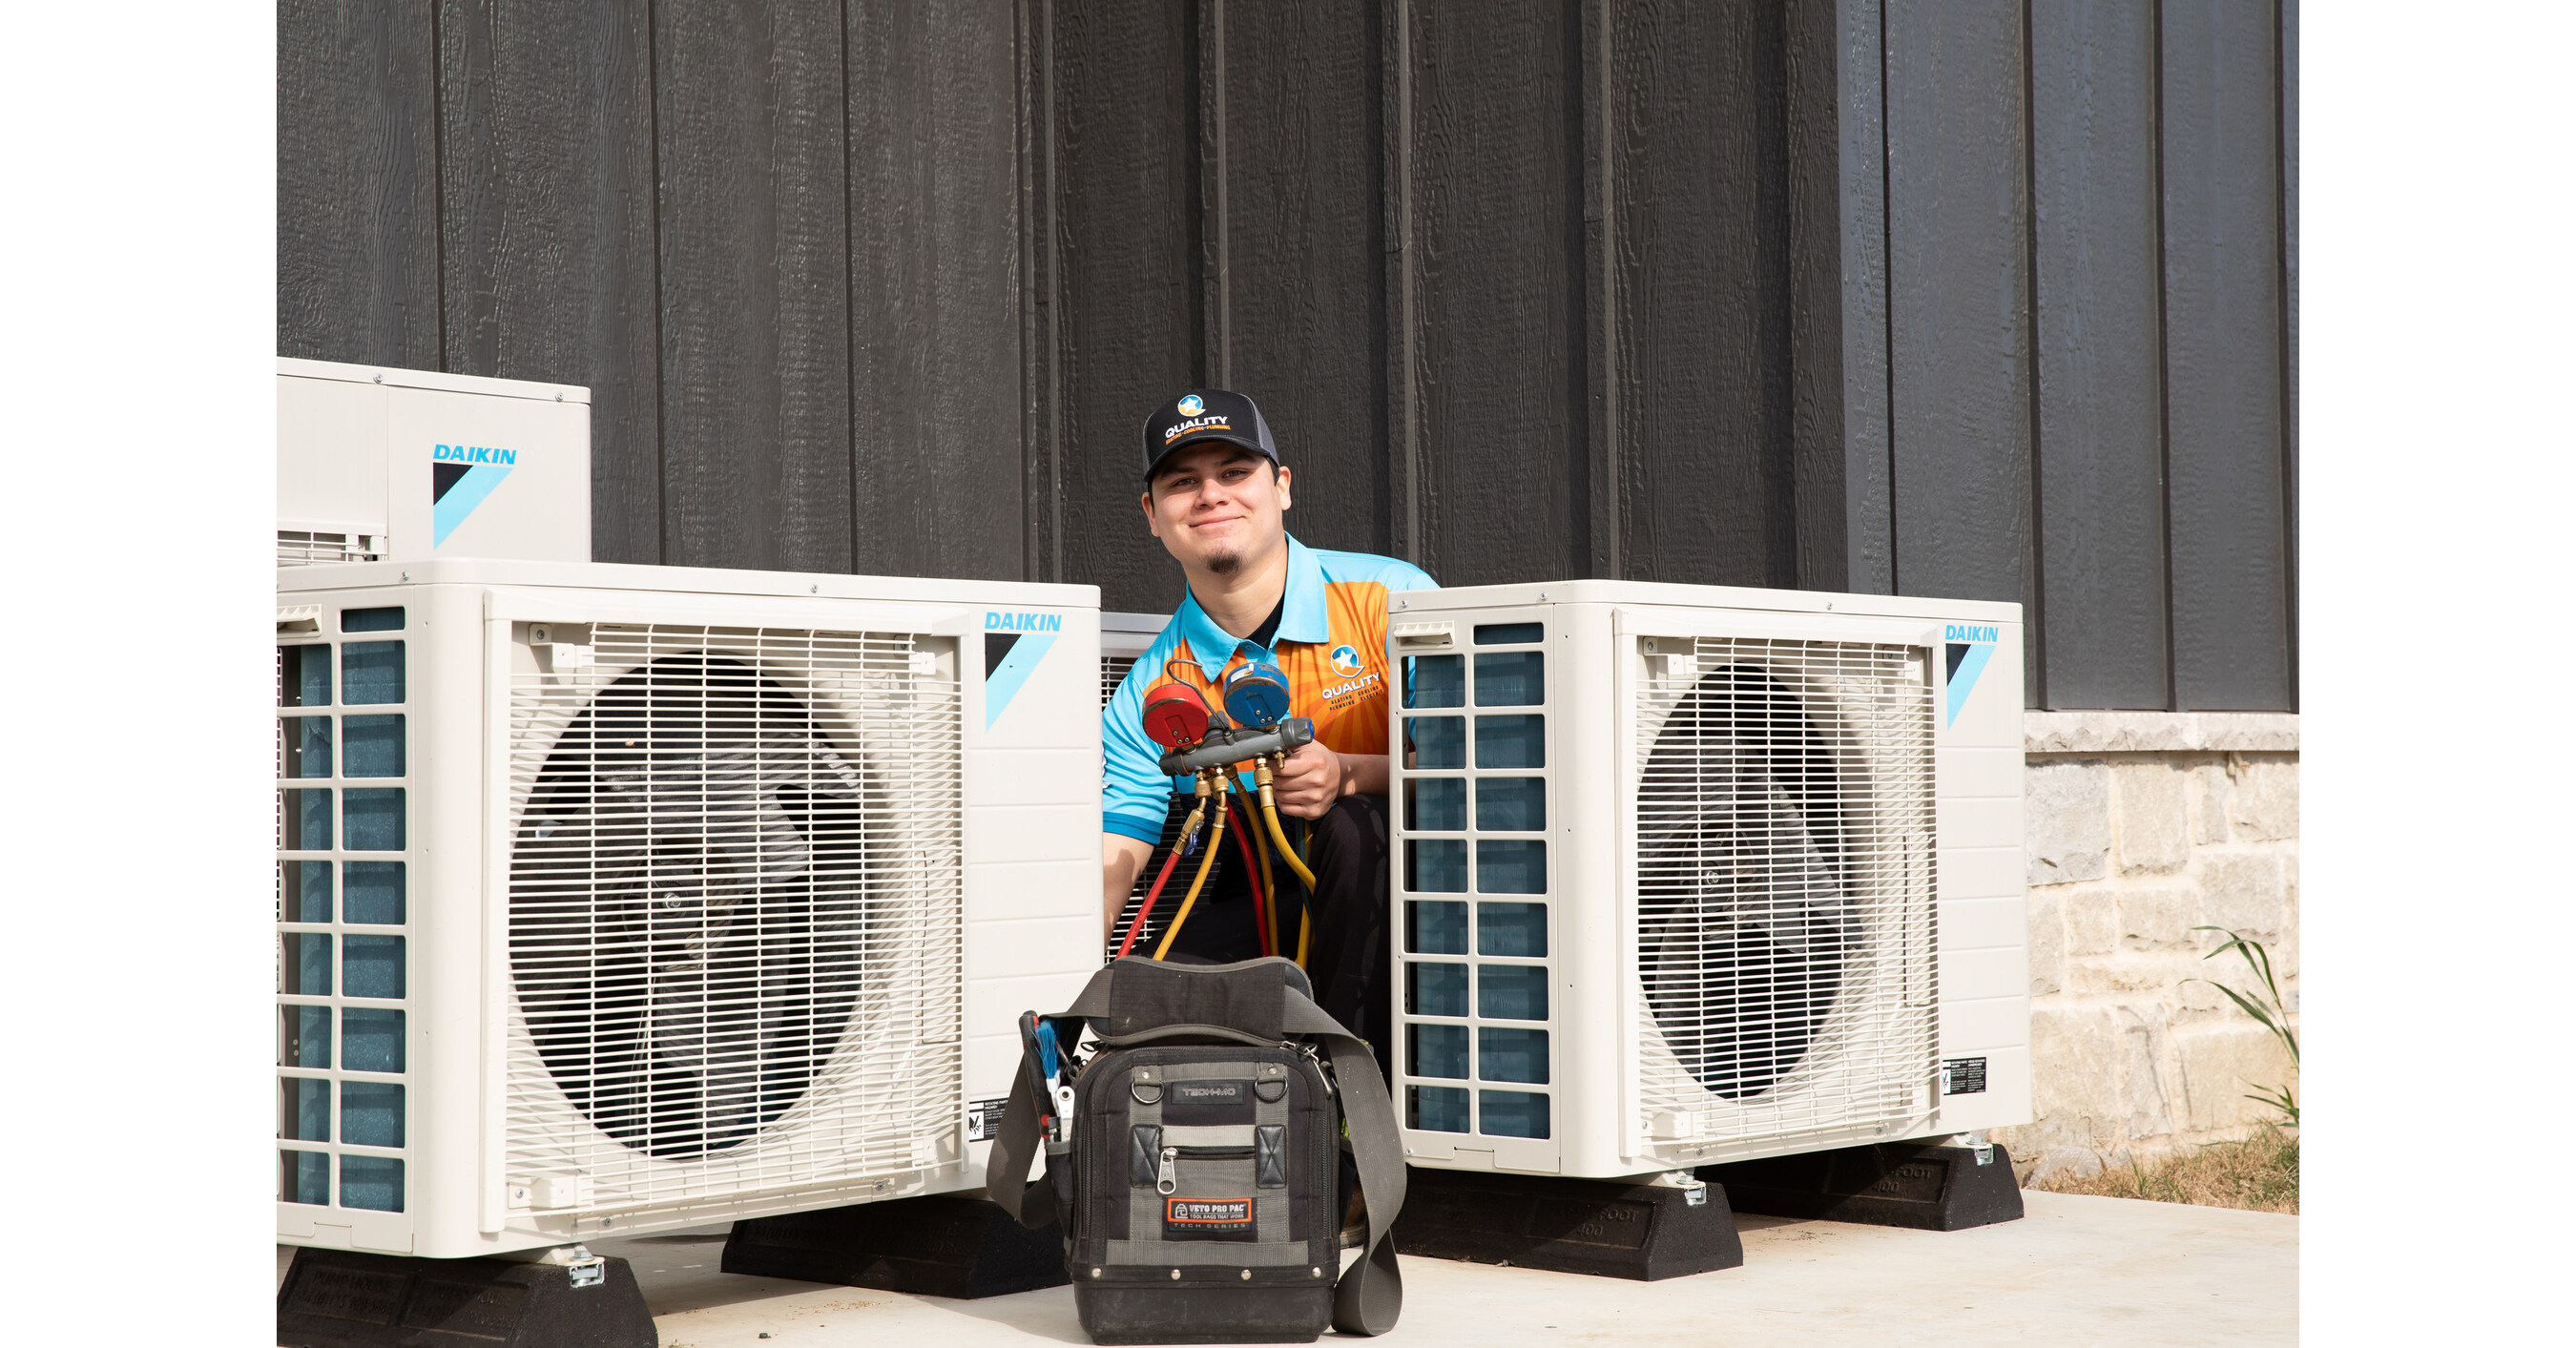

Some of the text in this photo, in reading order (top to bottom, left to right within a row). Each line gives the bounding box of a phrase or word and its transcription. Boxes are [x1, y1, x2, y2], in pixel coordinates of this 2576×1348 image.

[1165, 416, 1228, 438] QUALITY
[432, 444, 517, 466] DAIKIN
[985, 612, 1062, 632] DAIKIN
[1945, 625, 1999, 642] DAIKIN
[1321, 672, 1381, 699] QUALITY
[1331, 685, 1379, 705] HEATING COOLING
[1329, 699, 1355, 711] PLUMBING
[1189, 1204, 1210, 1213] VETO
[1212, 1204, 1228, 1213] PRO
